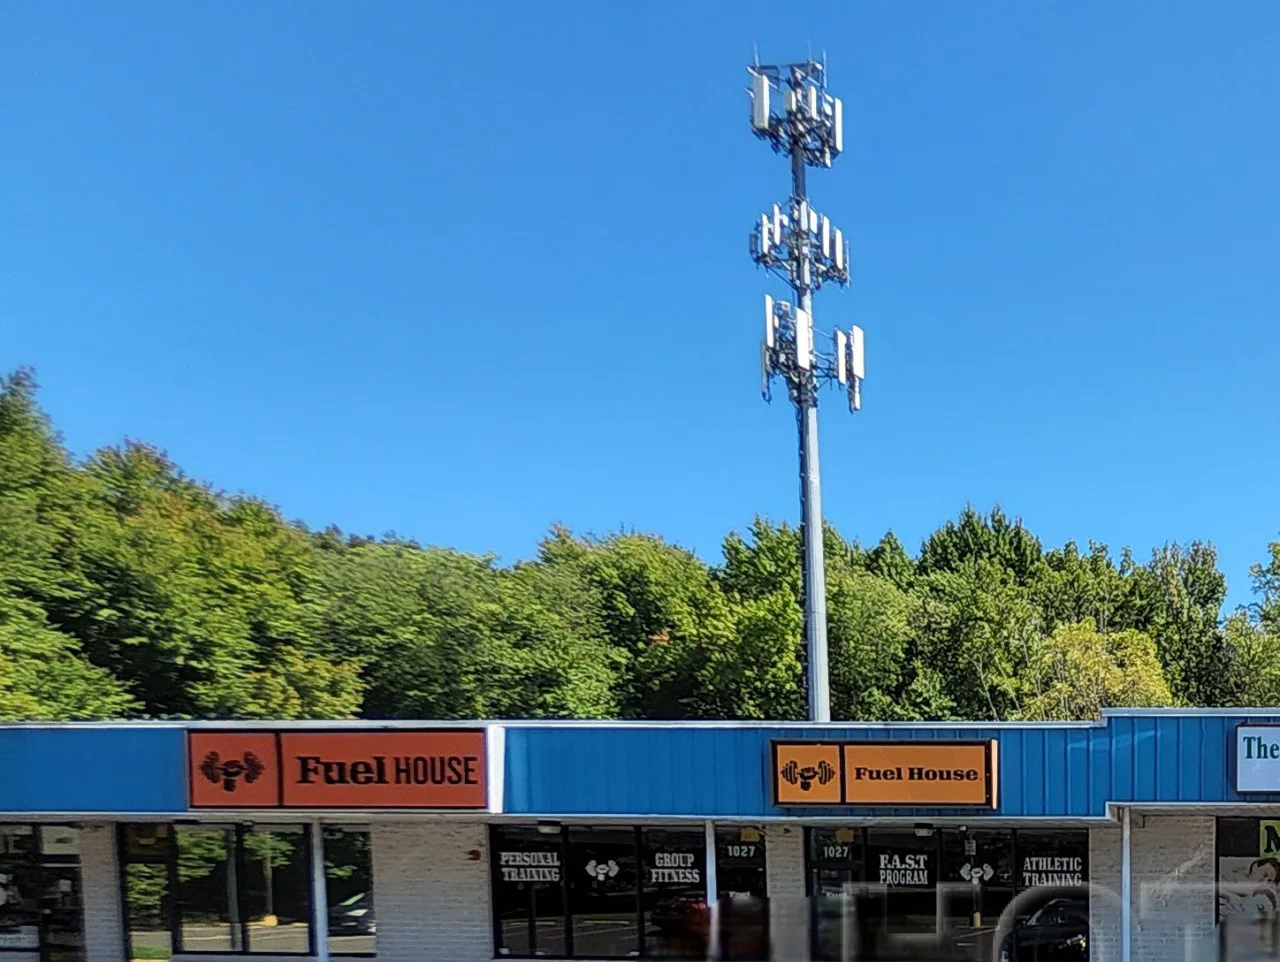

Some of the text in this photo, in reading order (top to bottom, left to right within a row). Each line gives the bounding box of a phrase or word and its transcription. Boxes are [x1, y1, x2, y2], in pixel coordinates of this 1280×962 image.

[1242, 736, 1280, 760] The
[296, 756, 478, 785] Fuel HOUSE
[854, 766, 979, 782] Fuel House
[500, 852, 561, 866] PERSONAL
[727, 845, 756, 858] 1027
[823, 846, 849, 858] 1027
[655, 853, 695, 867] GROUP
[1023, 857, 1082, 871] ATHLETIC
[501, 867, 560, 882] TRAINING
[650, 868, 700, 883] FITNESS
[879, 869, 928, 887] PROGRAM
[1023, 871, 1082, 887] TRAINING
